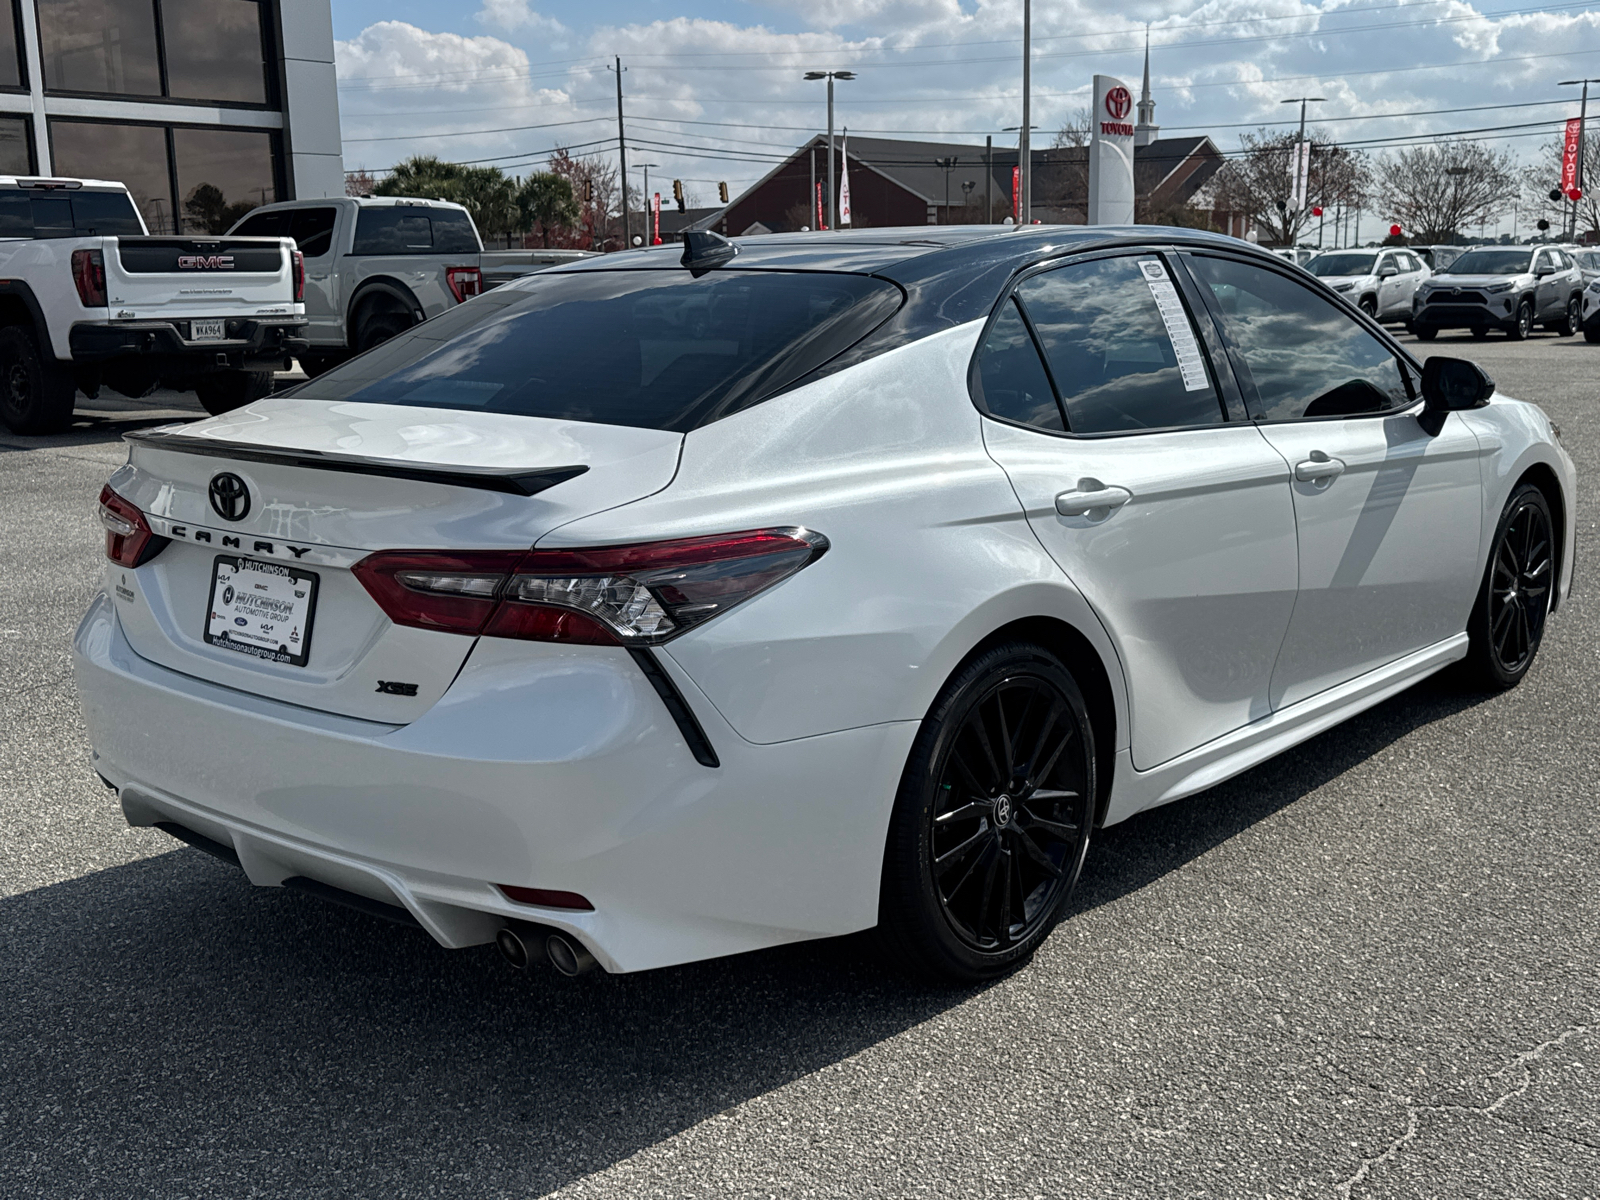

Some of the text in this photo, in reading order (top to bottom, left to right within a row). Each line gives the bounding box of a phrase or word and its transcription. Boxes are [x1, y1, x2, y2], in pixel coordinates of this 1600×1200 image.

[1100, 122, 1134, 136] TOYOTA
[1565, 134, 1578, 191] TOYOTA
[178, 256, 235, 269] GMC
[172, 526, 312, 558] CAMRY
[245, 560, 290, 577] HUTCHINSON
[235, 592, 294, 615] HUTCHINSON
[234, 605, 290, 623] AUTOMOTIVE GROUP
[212, 636, 291, 663] Hutchinsonautogroup.com
[375, 680, 419, 696] XSE
